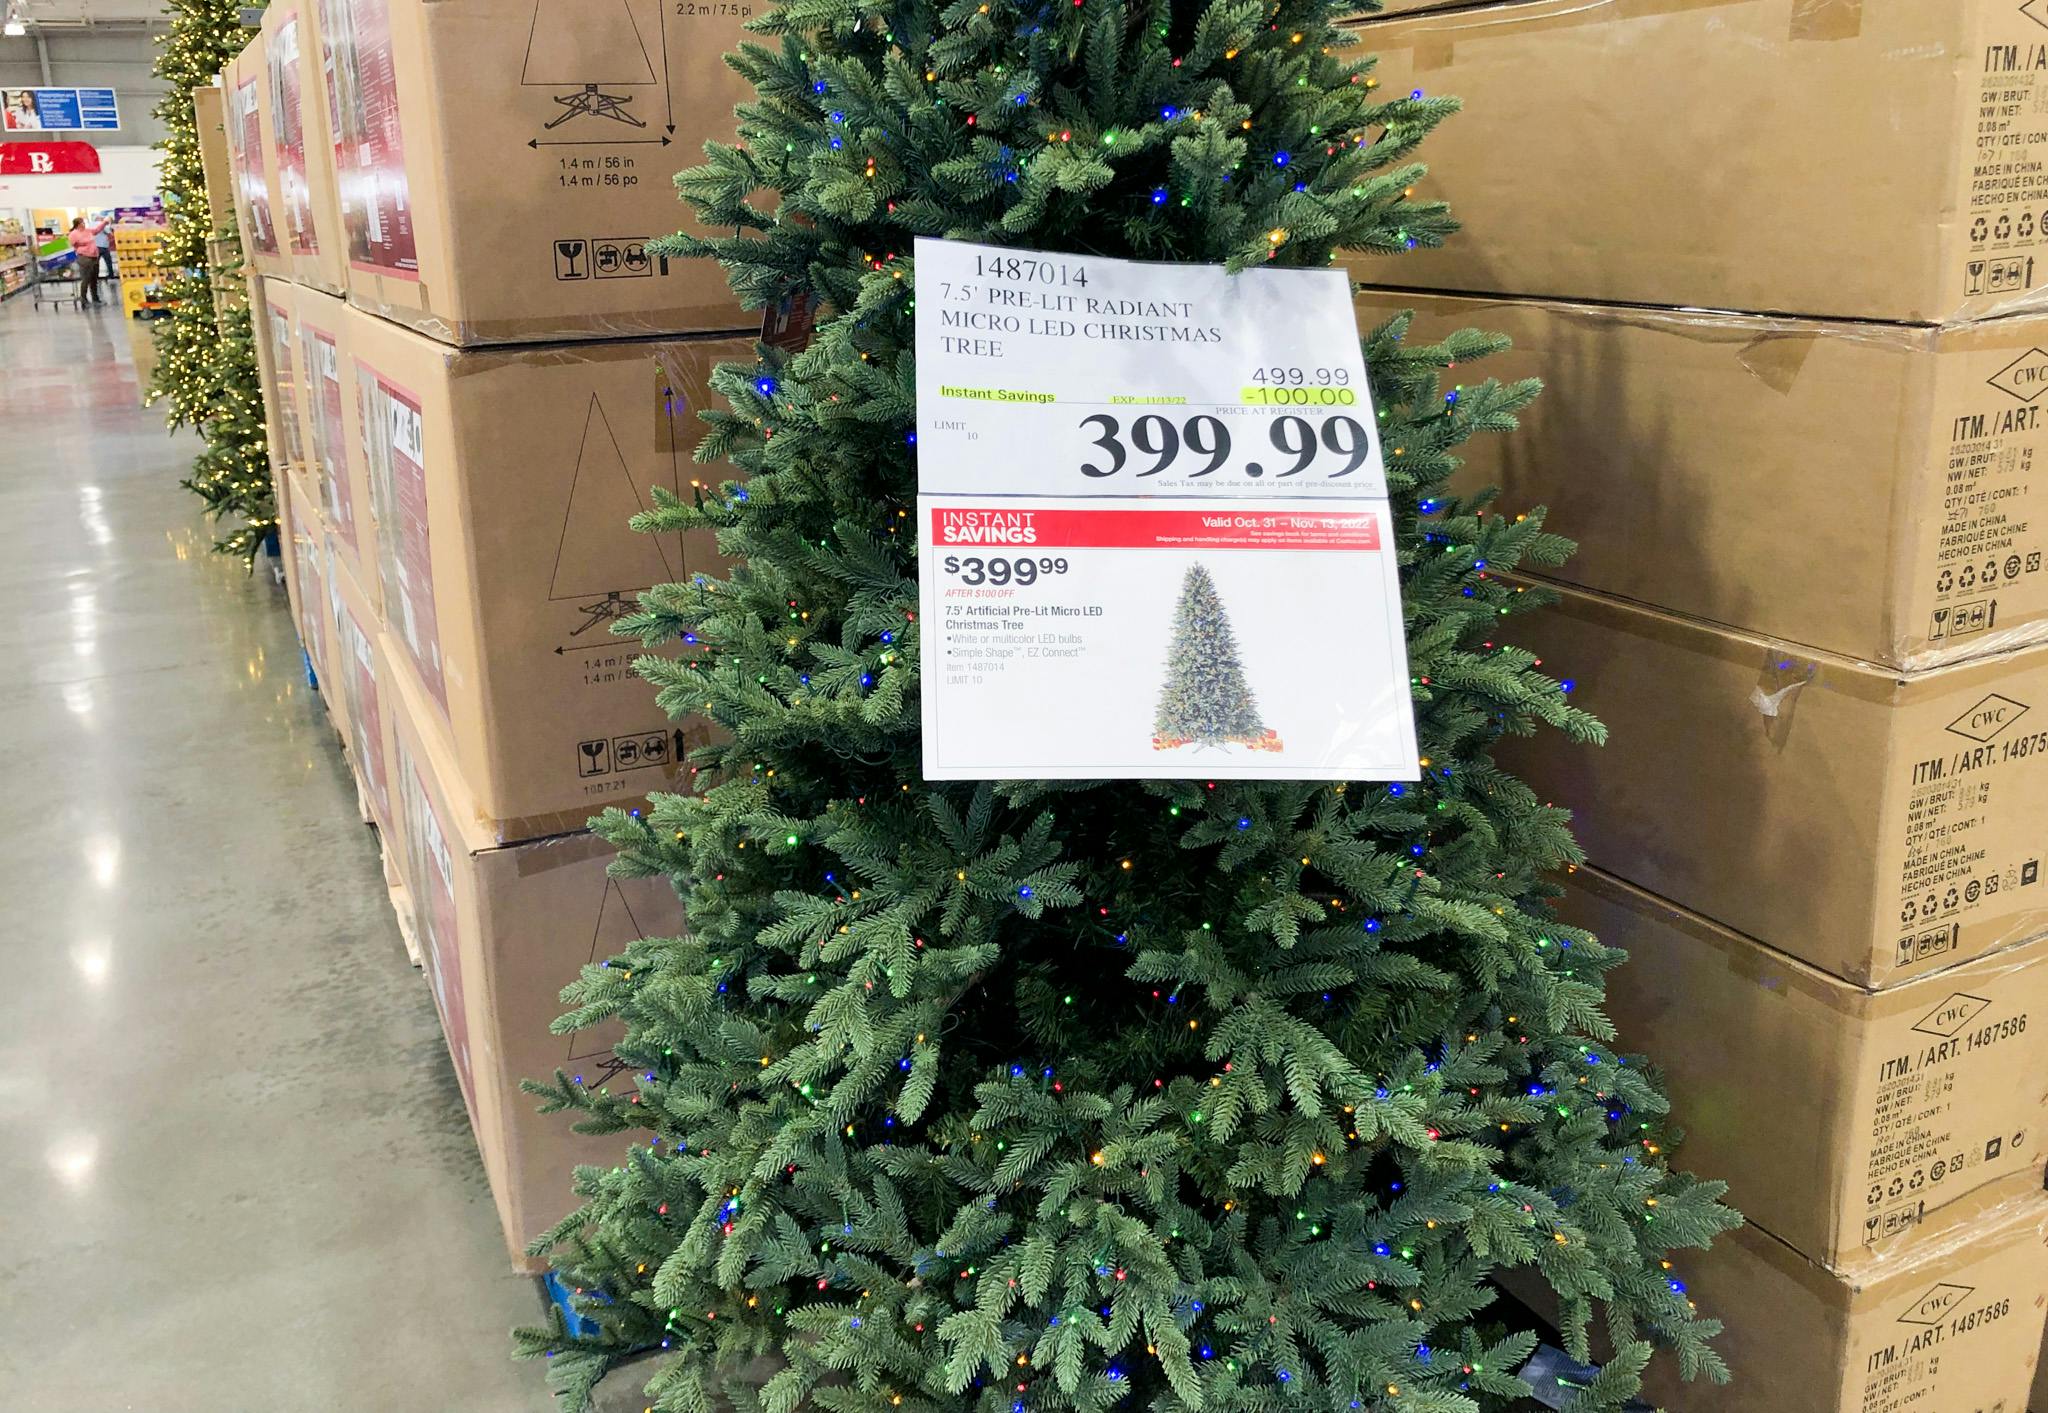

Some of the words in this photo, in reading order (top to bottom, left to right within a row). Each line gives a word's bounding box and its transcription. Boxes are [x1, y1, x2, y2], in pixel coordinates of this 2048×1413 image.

[676, 4, 695, 15] 2.2
[699, 6, 710, 15] m
[720, 4, 739, 15] 7.5
[560, 158, 578, 169] 1.4
[582, 159, 594, 169] m
[605, 157, 620, 168] 56
[624, 157, 634, 168] in
[1974, 164, 2001, 176] MADE
[2003, 164, 2012, 174] IN
[2015, 162, 2042, 174] CHINA
[560, 175, 578, 186] 1.4
[582, 177, 593, 186] m
[604, 175, 619, 186] 56
[624, 175, 638, 187] po
[2022, 176, 2034, 187] EN
[1971, 193, 2004, 206] HECHO
[2007, 192, 2019, 203] EN
[2021, 189, 2048, 202] CHINA
[975, 255, 1088, 288] 1487014
[989, 288, 1077, 312] PRE-LIT
[1087, 298, 1192, 318] RADIANT
[941, 310, 1020, 332] MICRO
[1029, 318, 1075, 337] LED
[1083, 323, 1222, 343] CHRISTMAS
[941, 336, 1003, 357] TREE
[1252, 367, 1349, 386] 499.99
[941, 385, 992, 400] Instant
[998, 389, 1055, 404] Savings
[1146, 396, 1187, 406] 11/13/22
[1246, 387, 1355, 406] -100.00
[1216, 407, 1249, 416] PRICE
[1252, 407, 1267, 416] AT
[1272, 407, 1324, 416] REGISTER
[934, 420, 967, 431] LIMIT
[968, 432, 978, 440] 10
[1078, 413, 1369, 479] 399.99
[2022, 447, 2033, 458] kg
[1158, 480, 1177, 488] Sales
[1180, 480, 1195, 488] Tax
[1197, 481, 1213, 490] may
[1215, 480, 1225, 488] be
[1255, 480, 1265, 488] all
[943, 512, 1035, 527] INSTANT
[1202, 517, 1232, 528] Valid
[1234, 517, 1260, 528] Oct.
[1263, 517, 1276, 528] 31
[1291, 518, 1315, 528] Nov.
[1321, 519, 1338, 530] 13,
[1341, 519, 1369, 529] 2022
[1941, 521, 1967, 536] MADE
[1968, 519, 1978, 531] IN
[1979, 514, 2007, 528] CHINA
[943, 527, 1037, 543] SAVINGS
[1987, 528, 1999, 540] EN
[2000, 522, 2028, 537] CHINE
[1938, 544, 1969, 561] HECHO
[1971, 543, 1983, 555] EN
[1985, 537, 2012, 552] CHINA
[945, 588, 973, 598] AFTER
[975, 588, 997, 598] $100
[998, 588, 1015, 598] OFF
[966, 606, 1010, 616] Artificial
[1013, 606, 1049, 616] Pre-Lit
[1051, 606, 1080, 616] Micro
[1083, 606, 1103, 616] LED
[945, 619, 999, 630] Christmas
[1001, 619, 1024, 630] Tree
[980, 636, 989, 644] or
[993, 634, 1035, 644] multicolor
[1038, 634, 1055, 644] LED
[1058, 634, 1082, 644] bulbs
[1028, 648, 1039, 657] EZ
[584, 659, 601, 670] 1.4
[605, 657, 616, 668] m
[947, 663, 964, 671] Item
[968, 663, 1004, 671] 1487014
[584, 673, 600, 685] 1.4
[605, 672, 615, 682] m
[947, 675, 968, 684] LIMIT
[973, 676, 982, 684] 10
[1971, 708, 2006, 729] CWC
[2002, 732, 2048, 762] 14875
[1980, 781, 1990, 792] kg
[1978, 793, 1988, 804] kg
[1906, 822, 1924, 835] 0.08
[1903, 855, 1928, 871] MADE
[1929, 852, 1938, 864] IN
[1940, 844, 1966, 860] CHINA
[1947, 858, 1959, 870] EN
[1960, 849, 1986, 865] CHINE
[1901, 877, 1932, 895] HECHO
[1933, 873, 1944, 886] EN
[1946, 865, 1972, 881] CHINA
[1936, 1004, 1968, 1026] CWC
[1966, 1013, 2027, 1052] 1487586
[1870, 1144, 1895, 1159] MADE
[1895, 1140, 1904, 1151] IN
[1906, 1130, 1932, 1146] CHINA
[1913, 1142, 1924, 1154] EN
[1926, 1132, 1951, 1148] CHINE
[1867, 1162, 1897, 1180] HECHO
[1899, 1158, 1910, 1170] EN
[1912, 1148, 1938, 1163] CHINA
[1920, 1293, 1953, 1316] CWC
[1952, 1298, 2010, 1337] 1487586
